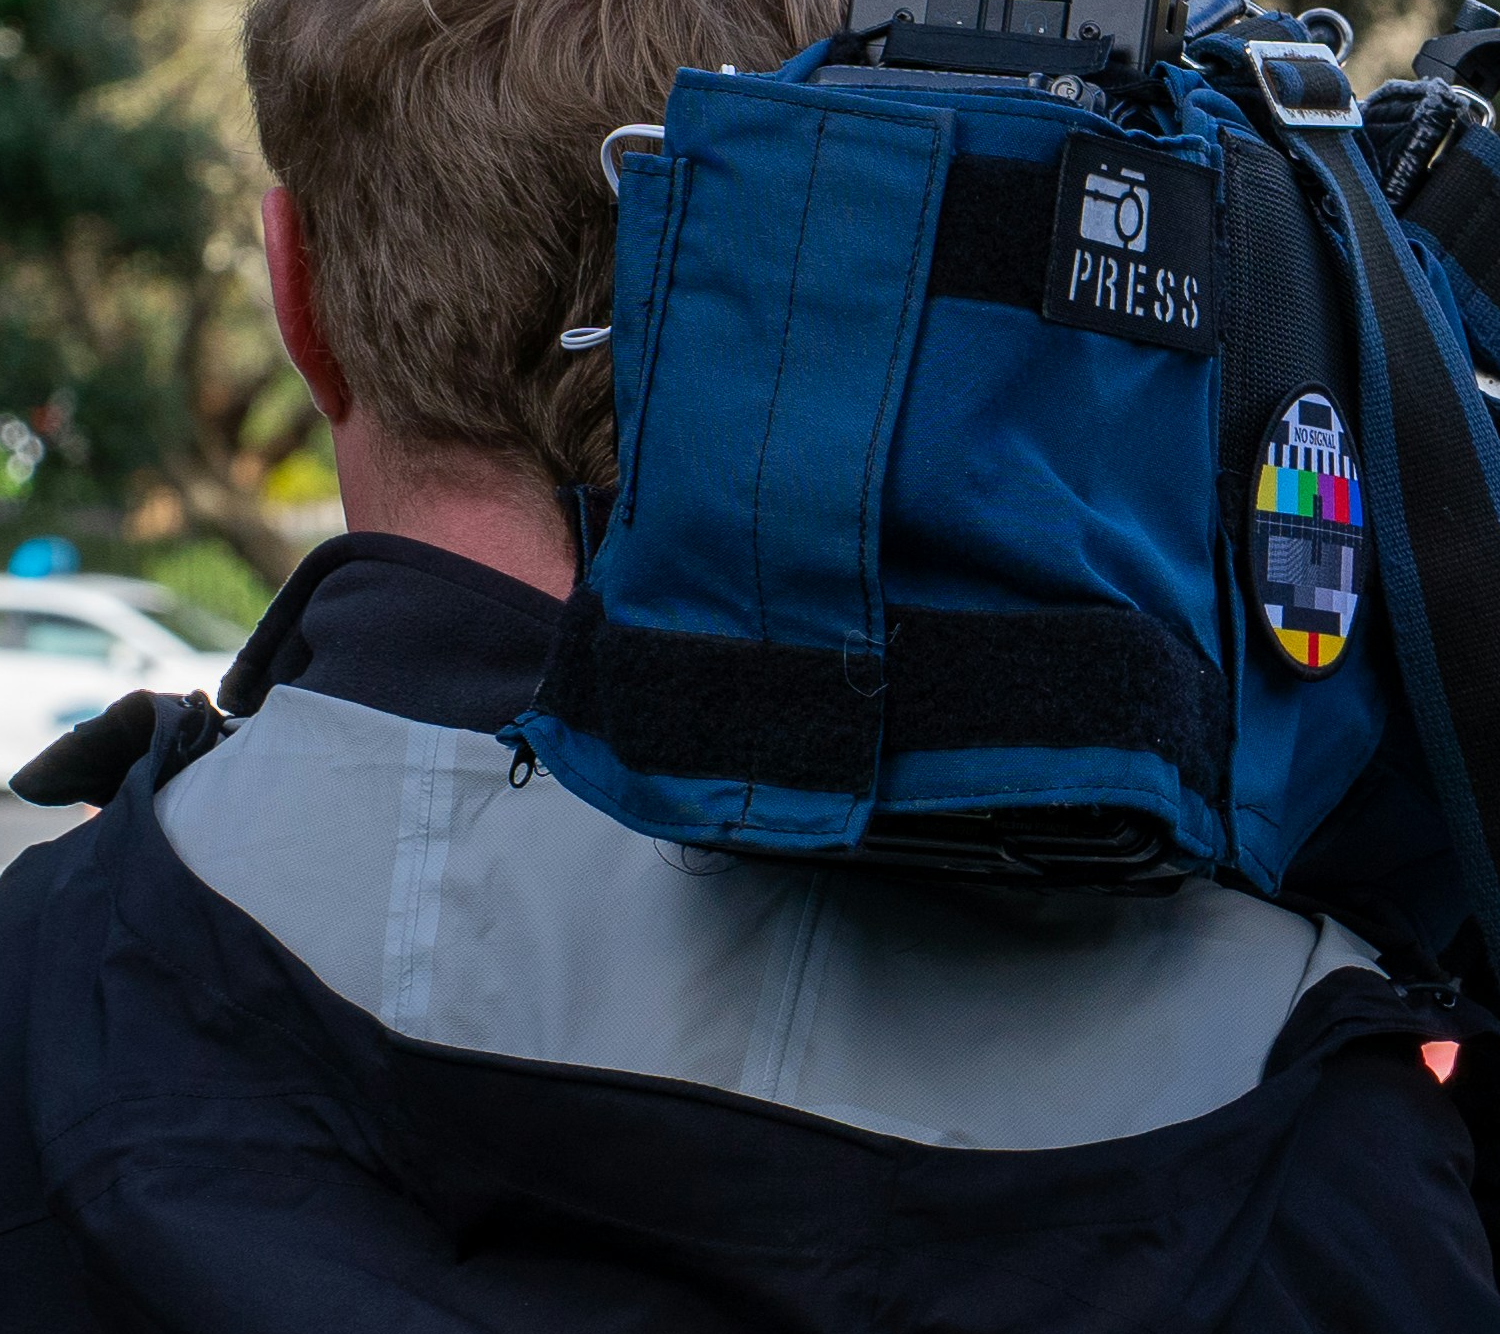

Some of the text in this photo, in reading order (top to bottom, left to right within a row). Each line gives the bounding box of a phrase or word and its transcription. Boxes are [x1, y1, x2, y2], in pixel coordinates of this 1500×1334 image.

[1069, 248, 1199, 329] PRESS
[1294, 426, 1336, 450] NO SIGNAL
